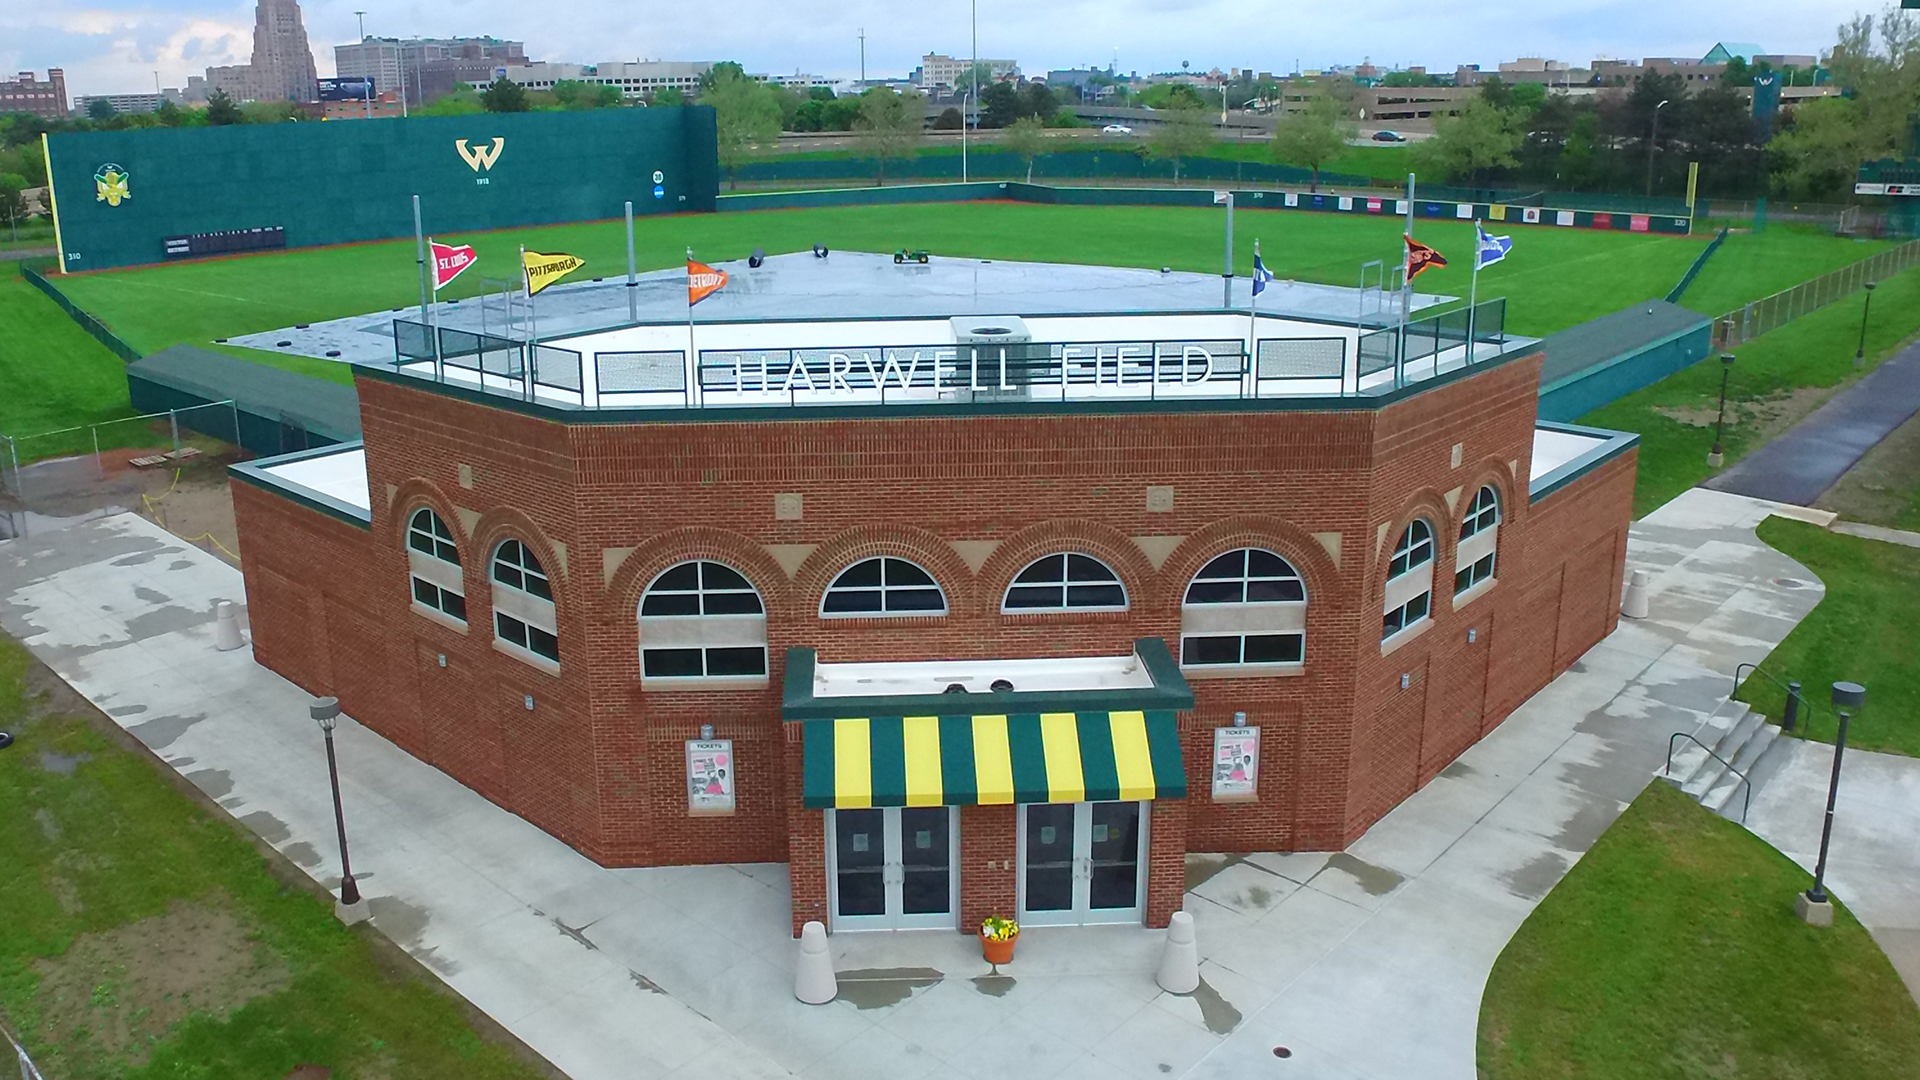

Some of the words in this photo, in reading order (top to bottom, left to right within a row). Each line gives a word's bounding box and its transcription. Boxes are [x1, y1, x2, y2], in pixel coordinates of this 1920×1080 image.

[455, 136, 505, 172] W
[68, 252, 81, 261] 310
[528, 257, 578, 277] PITTSBURGH
[735, 347, 1017, 396] HARWELL
[1061, 345, 1214, 389] FIELD
